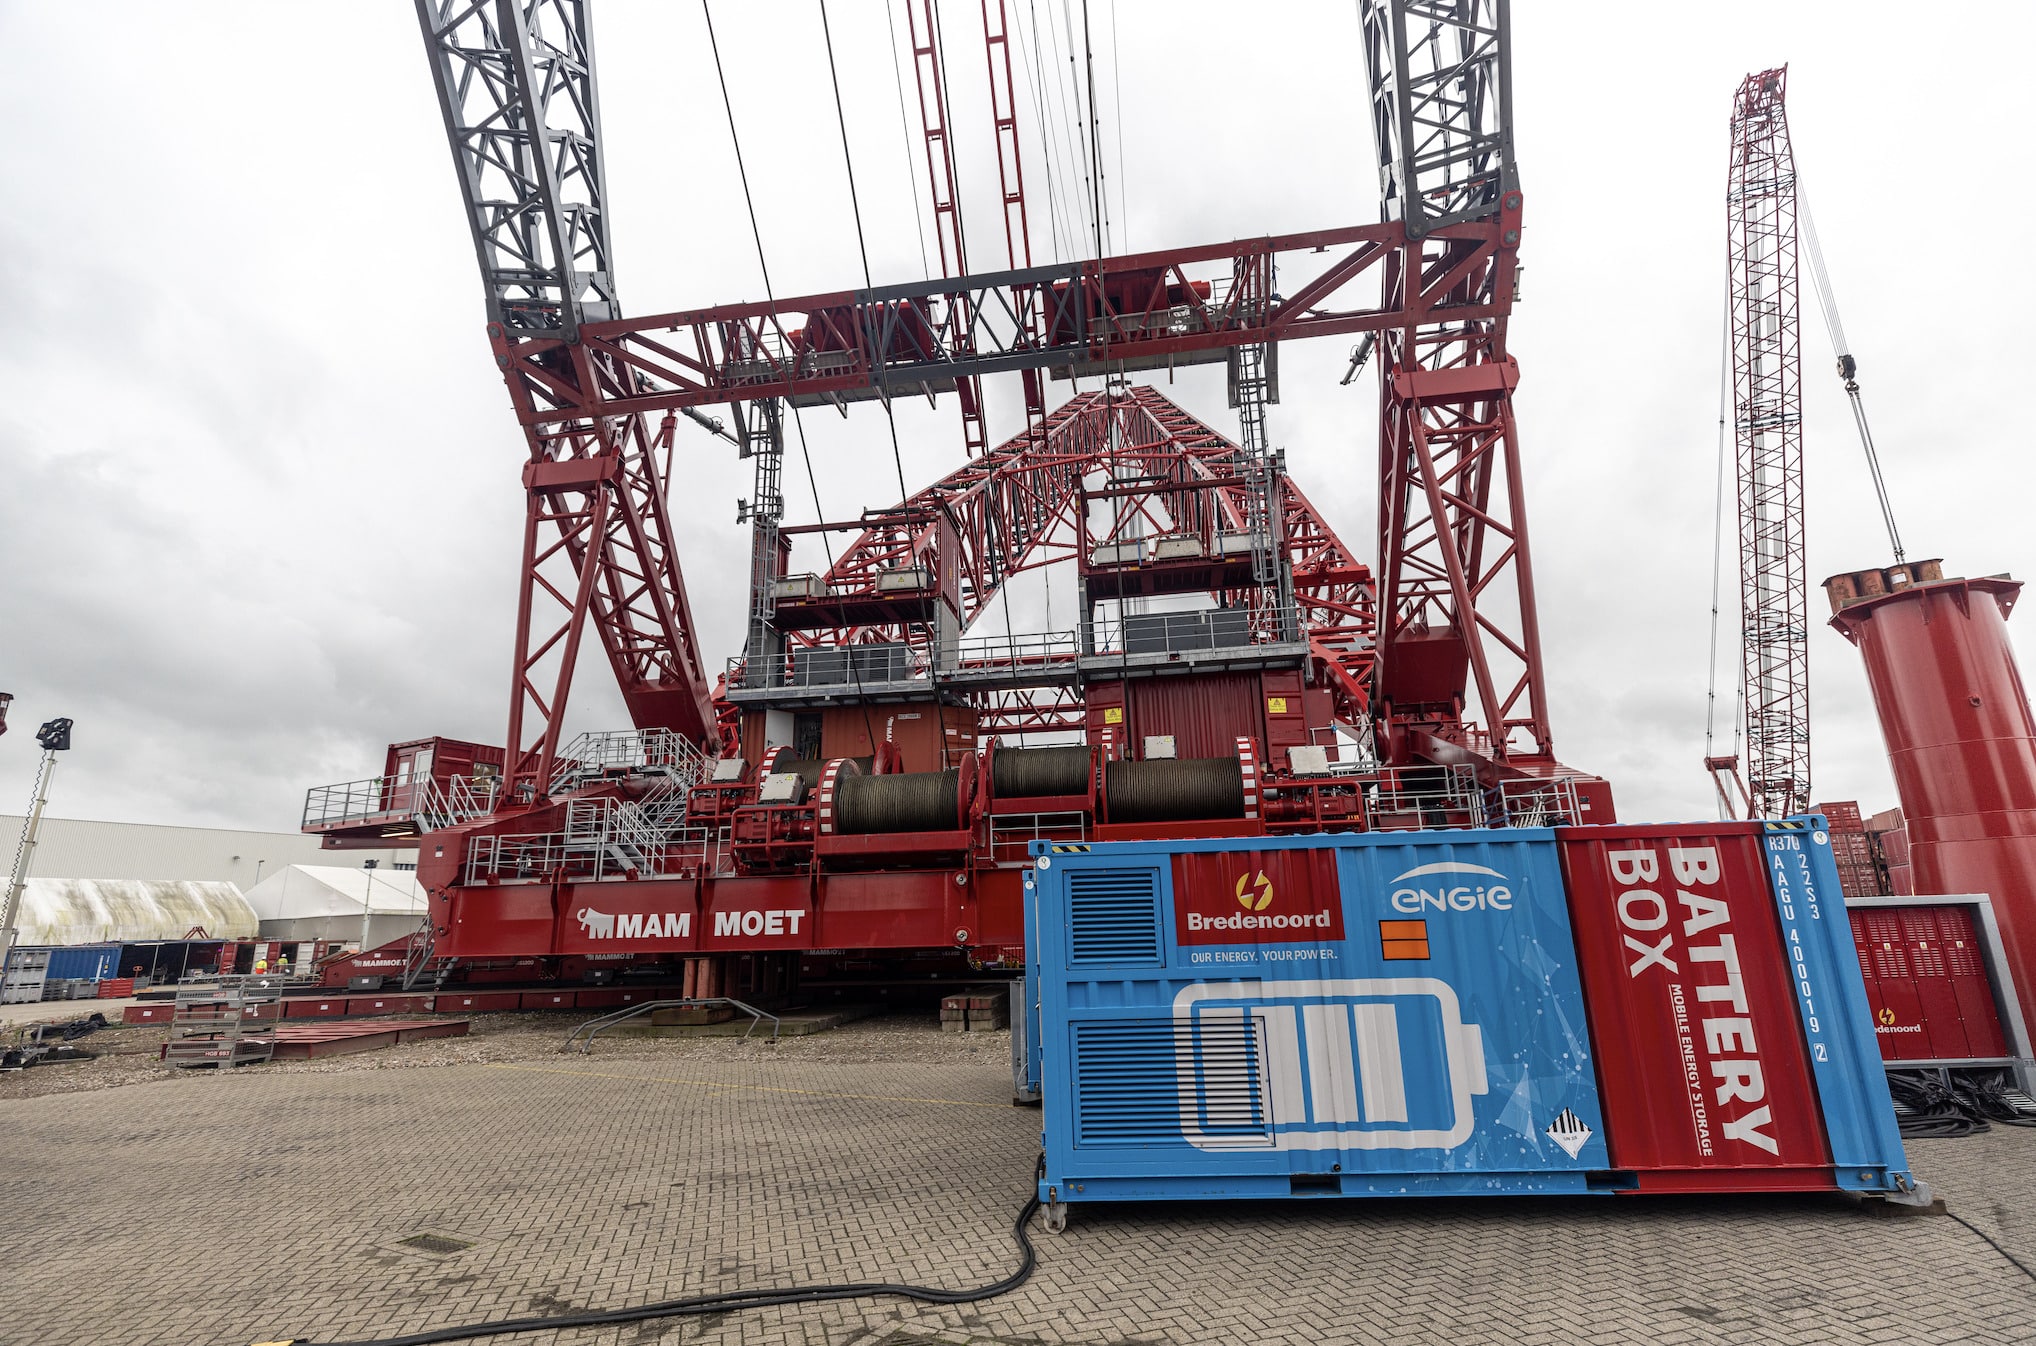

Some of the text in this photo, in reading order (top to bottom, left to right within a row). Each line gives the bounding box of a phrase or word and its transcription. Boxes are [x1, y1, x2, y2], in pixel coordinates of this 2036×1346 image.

[1769, 836, 1801, 851] R370
[714, 909, 806, 937] MOET
[1187, 909, 1331, 931] Bredenoord
[1608, 849, 1679, 979] BOX
[1191, 952, 1213, 964] OUR
[1215, 951, 1259, 963] ENERGY.
[1262, 950, 1293, 961] YOUR
[1790, 928, 1820, 1033] 400019
[1815, 1043, 1828, 1062] 2
[1668, 847, 1780, 1157] BATTERY
[1671, 984, 1714, 1157] MOBILE ENERGY STORAGE
